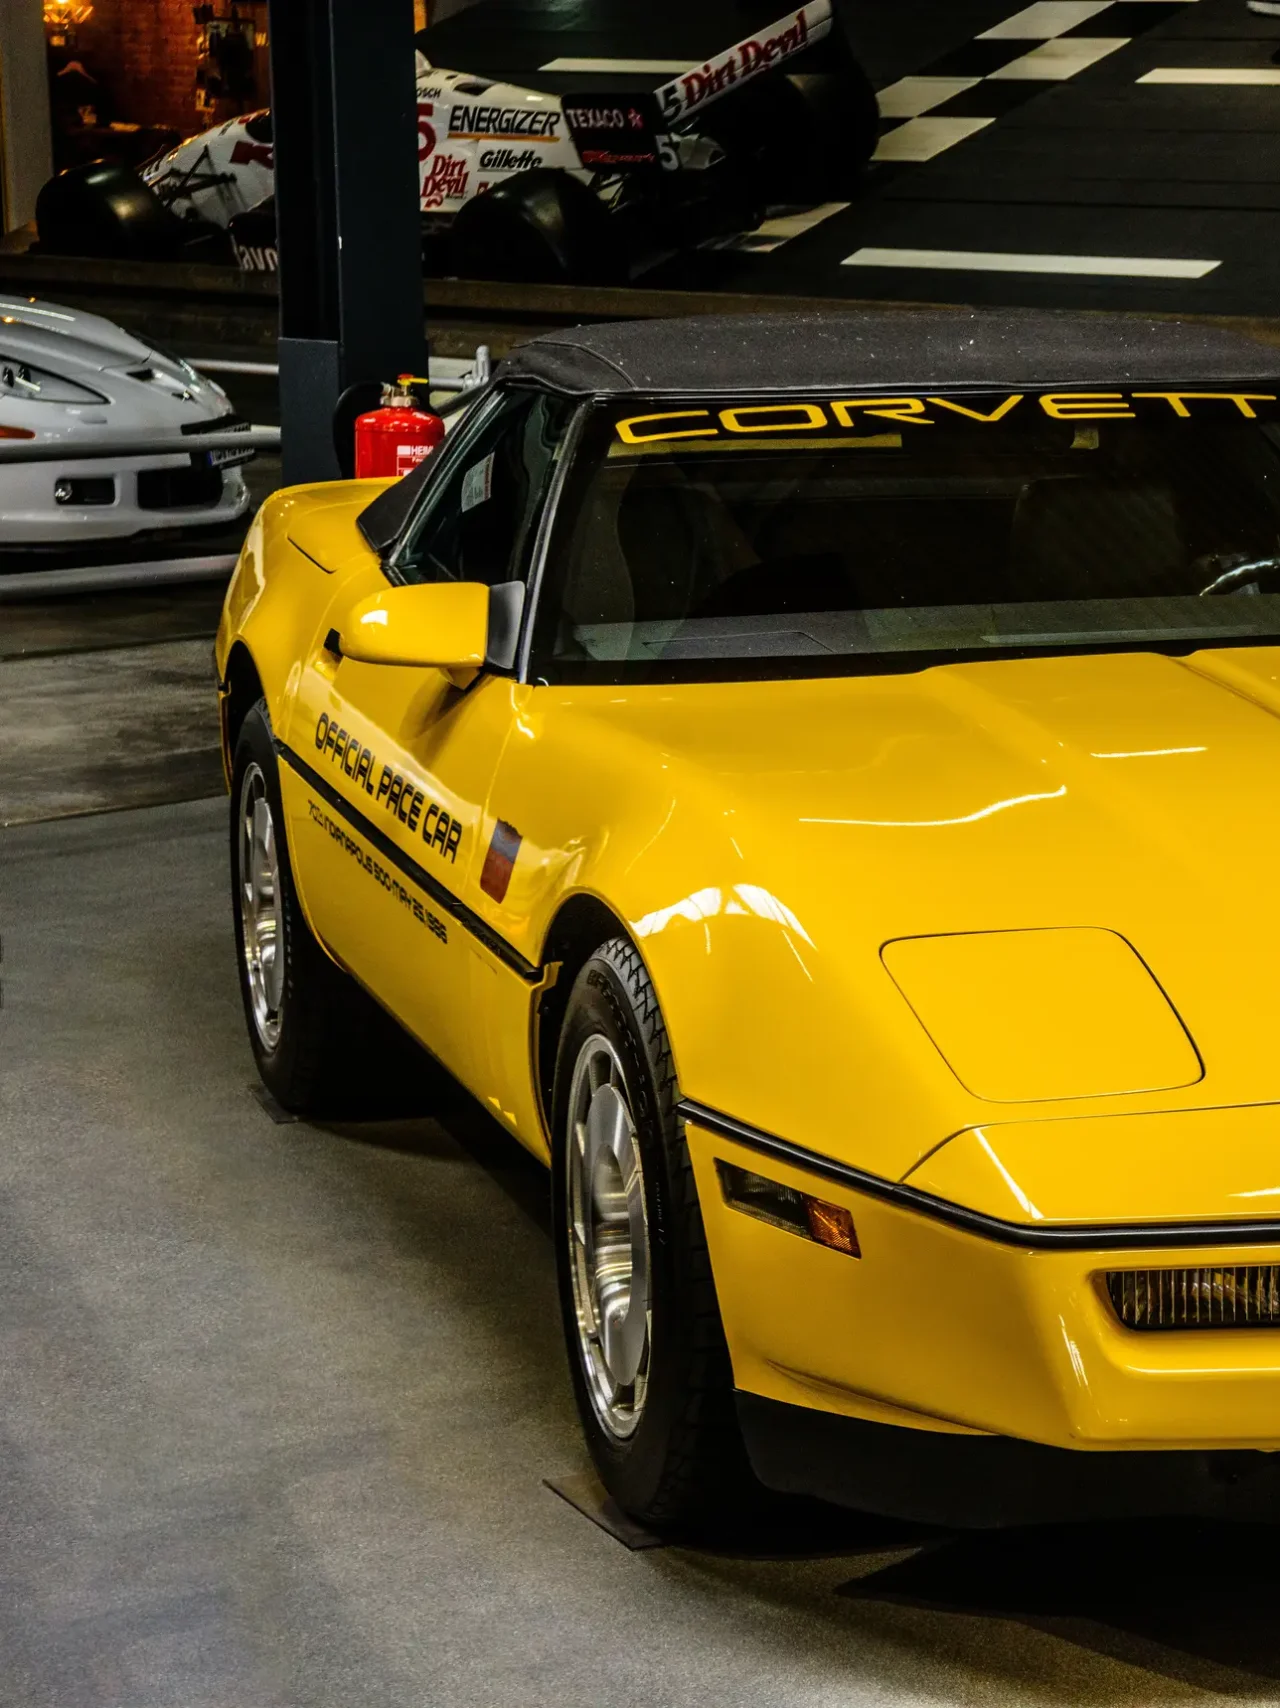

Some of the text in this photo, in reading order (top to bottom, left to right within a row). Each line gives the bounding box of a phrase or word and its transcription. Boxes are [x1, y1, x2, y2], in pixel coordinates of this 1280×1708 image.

[681, 57, 738, 111] Dirt
[737, 9, 808, 78] Devil
[416, 86, 442, 99] OSCH
[449, 104, 561, 136] ENERGIZER
[565, 107, 625, 129] TEXACO
[430, 153, 466, 177] Dirt
[479, 149, 543, 170] Gillette
[655, 133, 680, 172] 5
[421, 171, 470, 198] Devil
[315, 712, 463, 864] OFFICIAL PACE CAR
